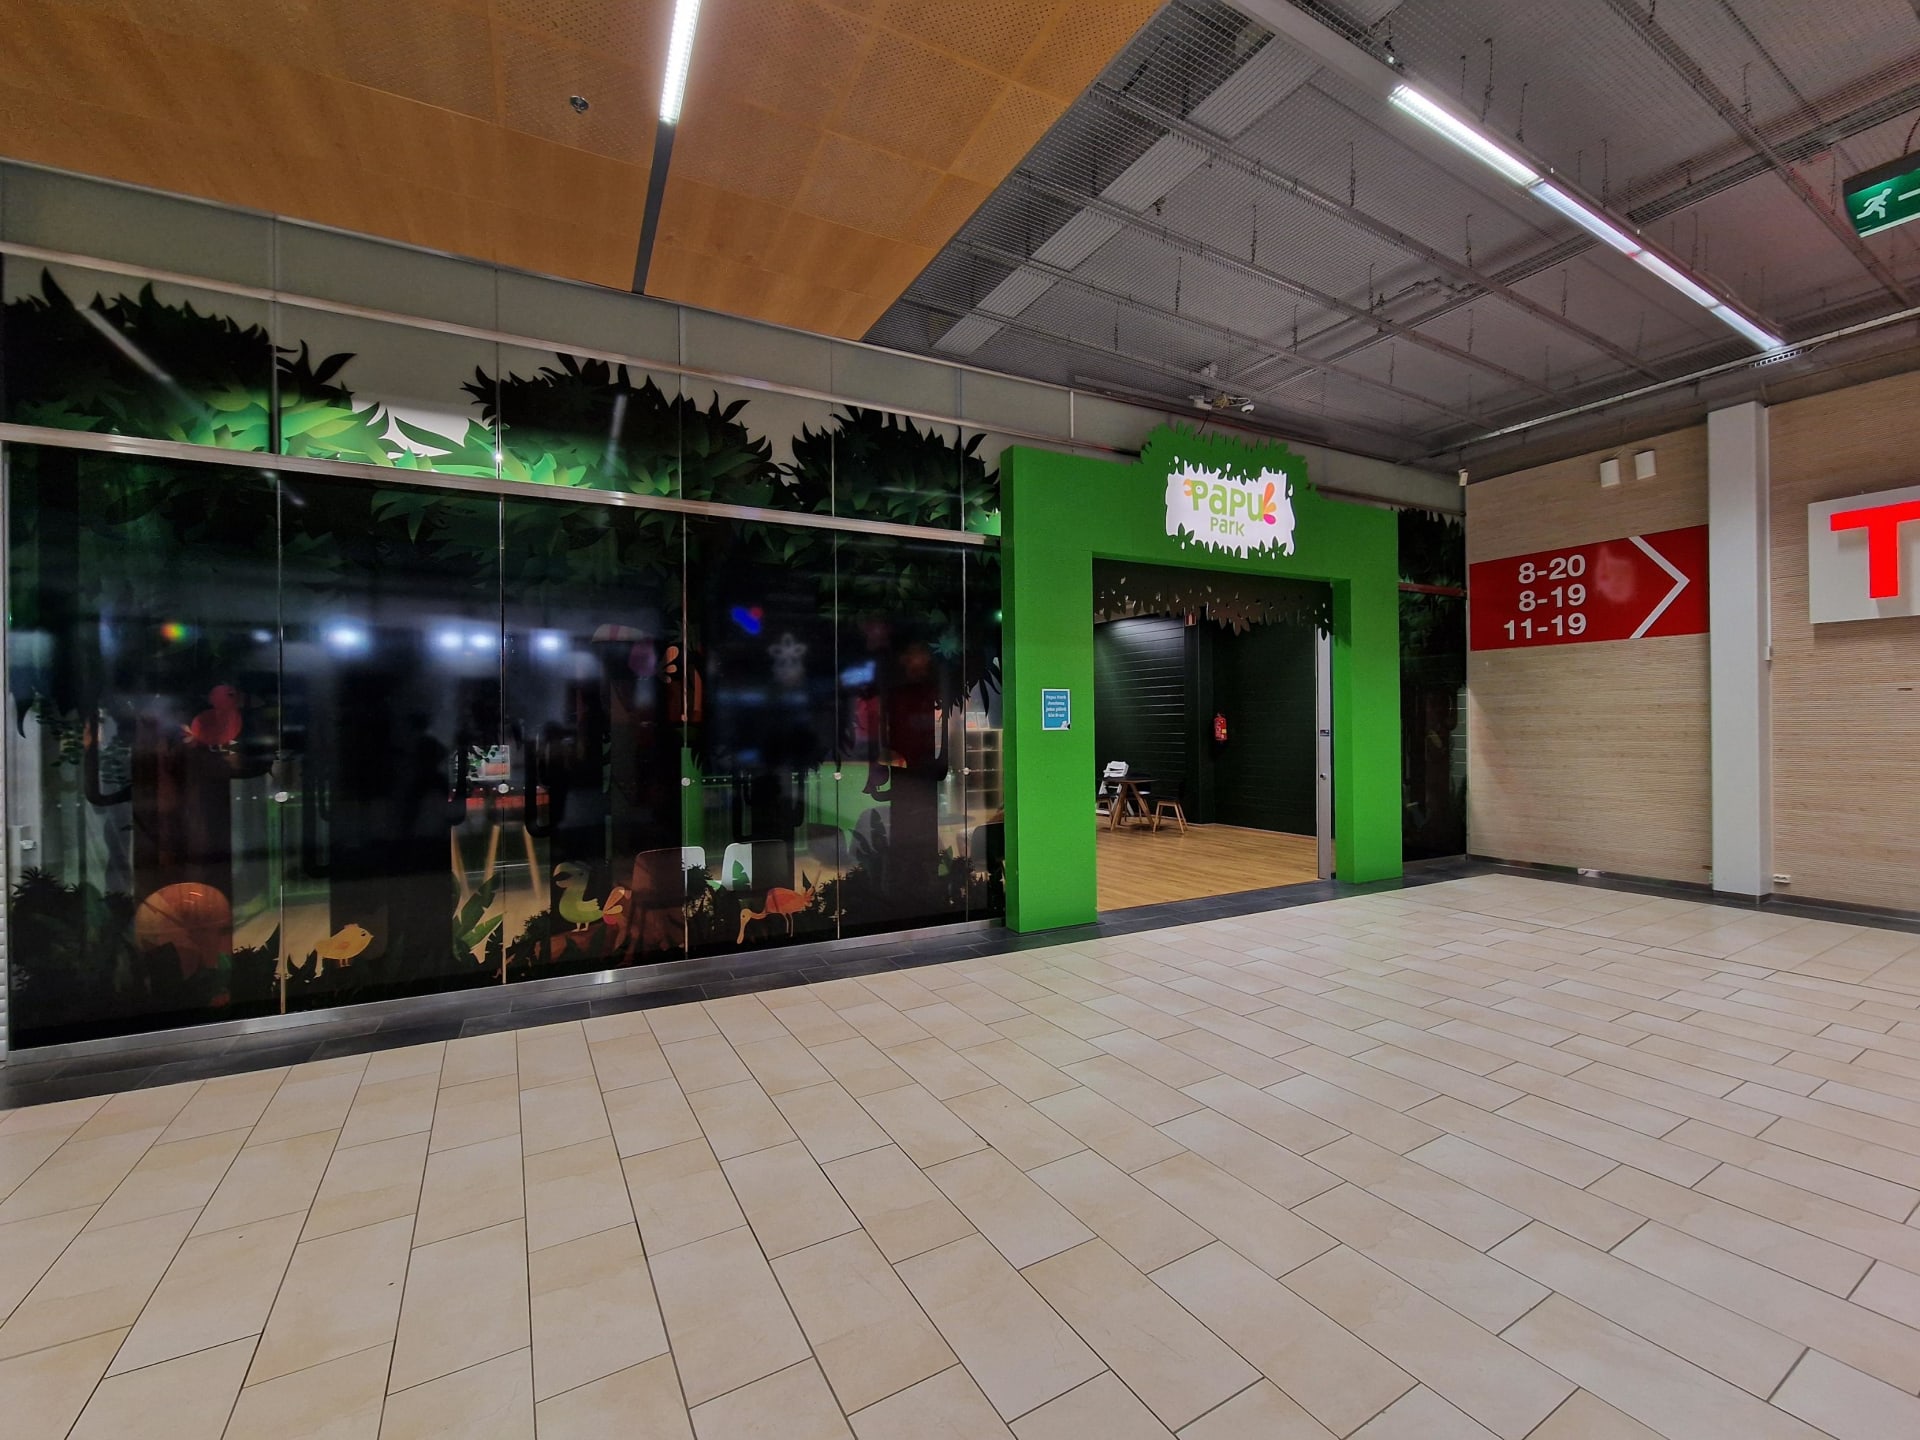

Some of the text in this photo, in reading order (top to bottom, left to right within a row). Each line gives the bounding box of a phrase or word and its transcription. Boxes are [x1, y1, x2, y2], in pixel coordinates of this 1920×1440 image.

[1518, 554, 1586, 584] 8-20
[1518, 583, 1586, 612] 8-19
[1503, 612, 1587, 640] 11-19
